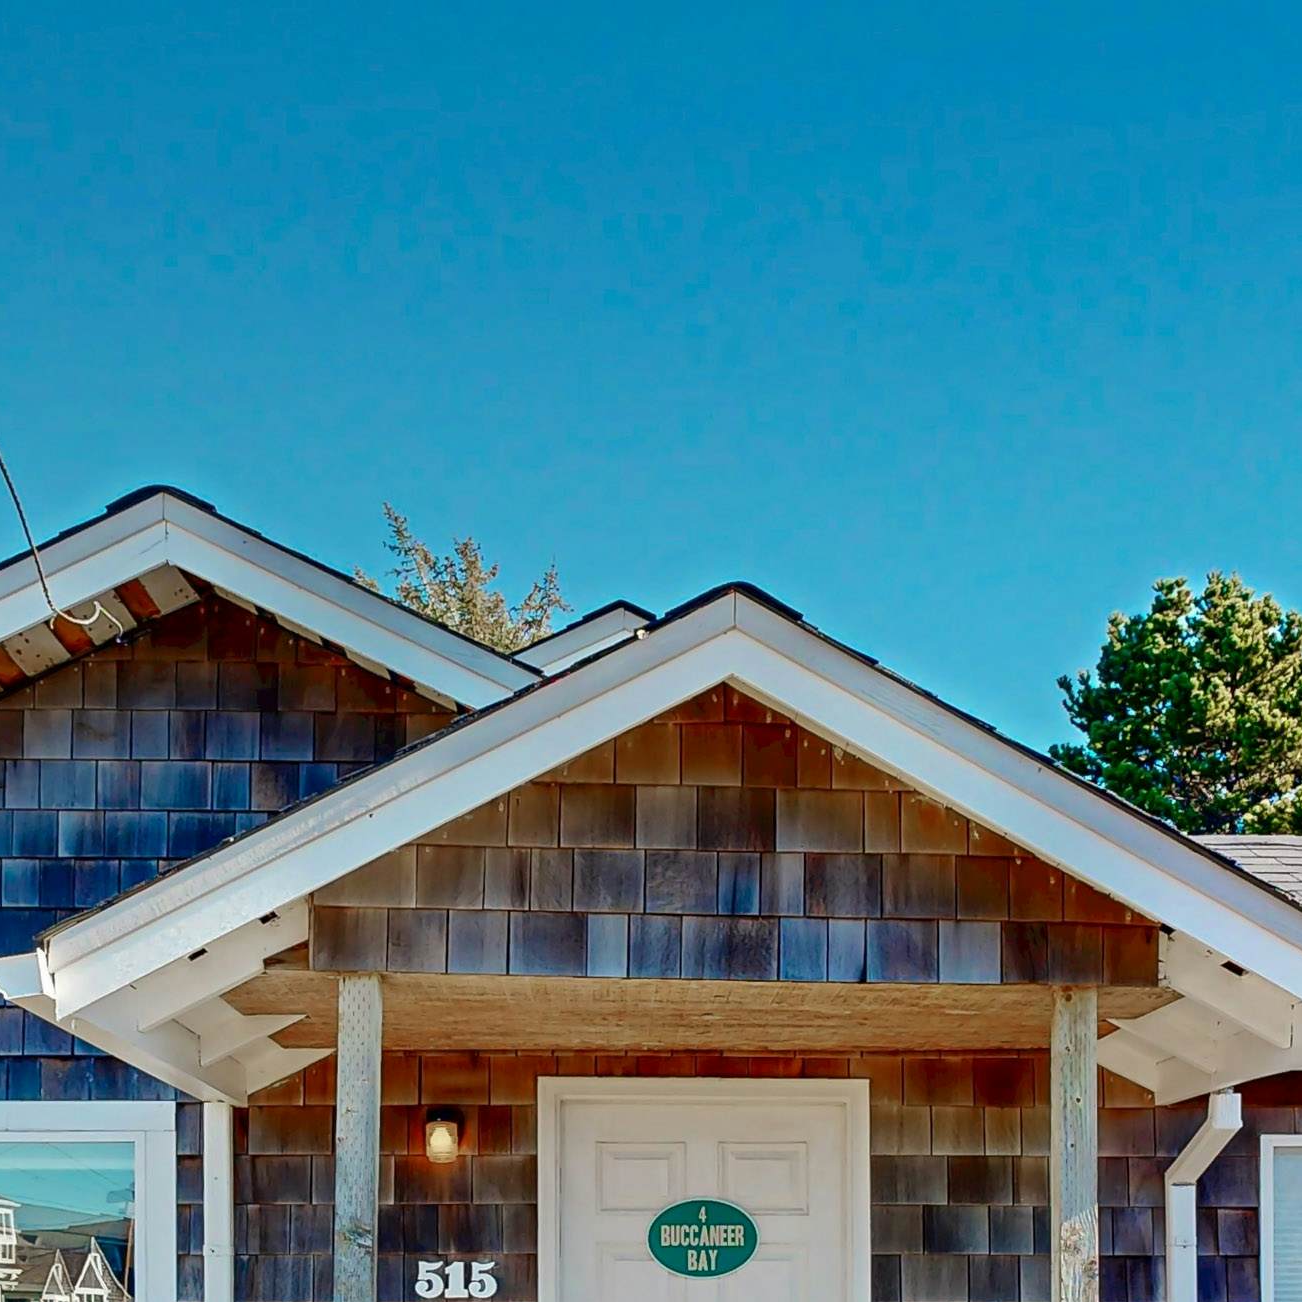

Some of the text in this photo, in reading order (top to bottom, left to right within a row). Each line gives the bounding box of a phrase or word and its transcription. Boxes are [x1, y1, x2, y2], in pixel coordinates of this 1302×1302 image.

[698, 1206, 707, 1223] 4
[660, 1224, 745, 1247] BUCCANEER
[687, 1249, 718, 1271] BAY
[414, 1260, 498, 1299] 515
